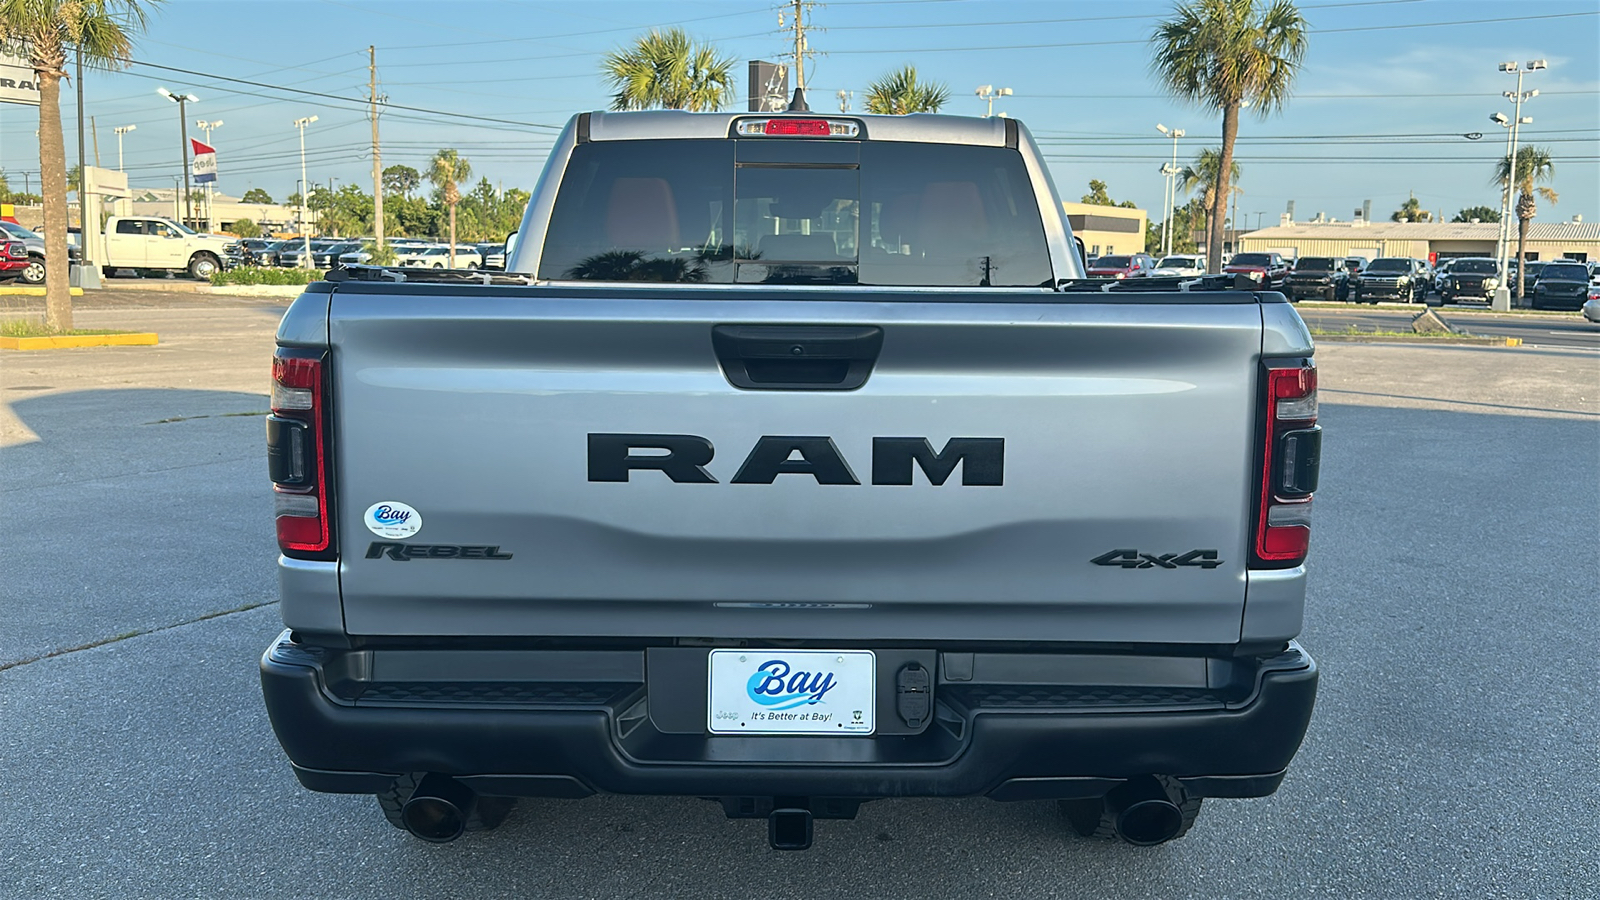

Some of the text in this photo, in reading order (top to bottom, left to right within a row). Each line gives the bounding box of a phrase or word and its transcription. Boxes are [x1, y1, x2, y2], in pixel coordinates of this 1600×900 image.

[588, 433, 1004, 486] RAM
[377, 505, 411, 524] Bay
[754, 660, 837, 705] Bay
[716, 711, 739, 721] Jeep
[751, 712, 833, 722] It's Better at Bay!
